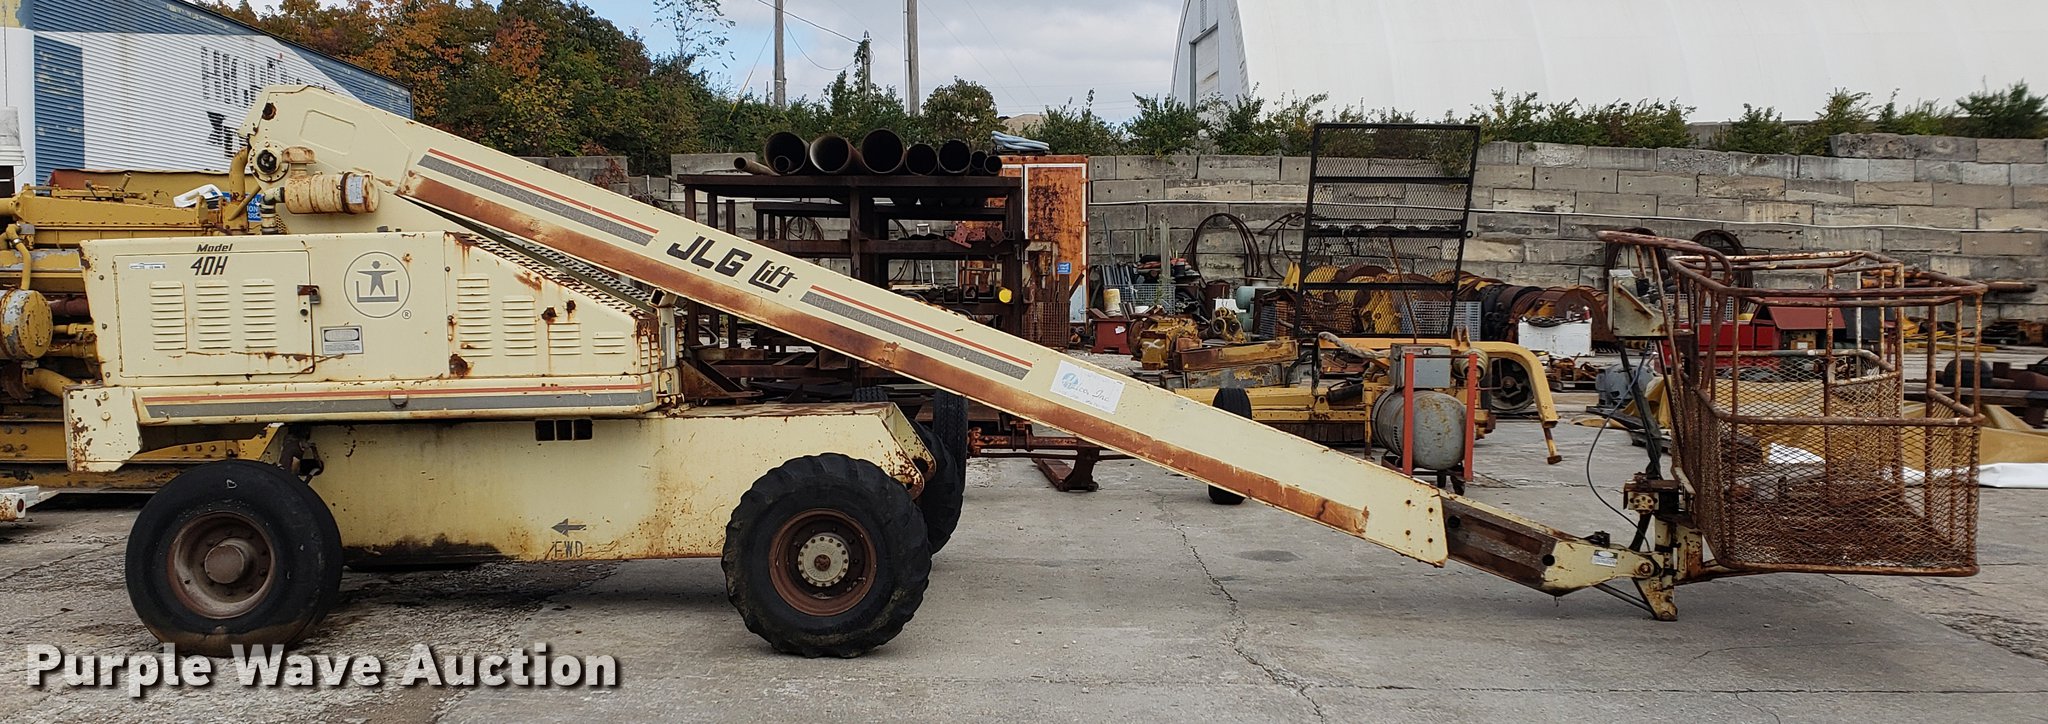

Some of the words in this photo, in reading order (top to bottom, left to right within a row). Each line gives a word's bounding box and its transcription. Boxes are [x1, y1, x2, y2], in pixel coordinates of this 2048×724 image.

[196, 243, 233, 253] Model
[666, 235, 753, 278] JLG
[747, 260, 798, 293] Lift
[553, 540, 584, 558] FWD
